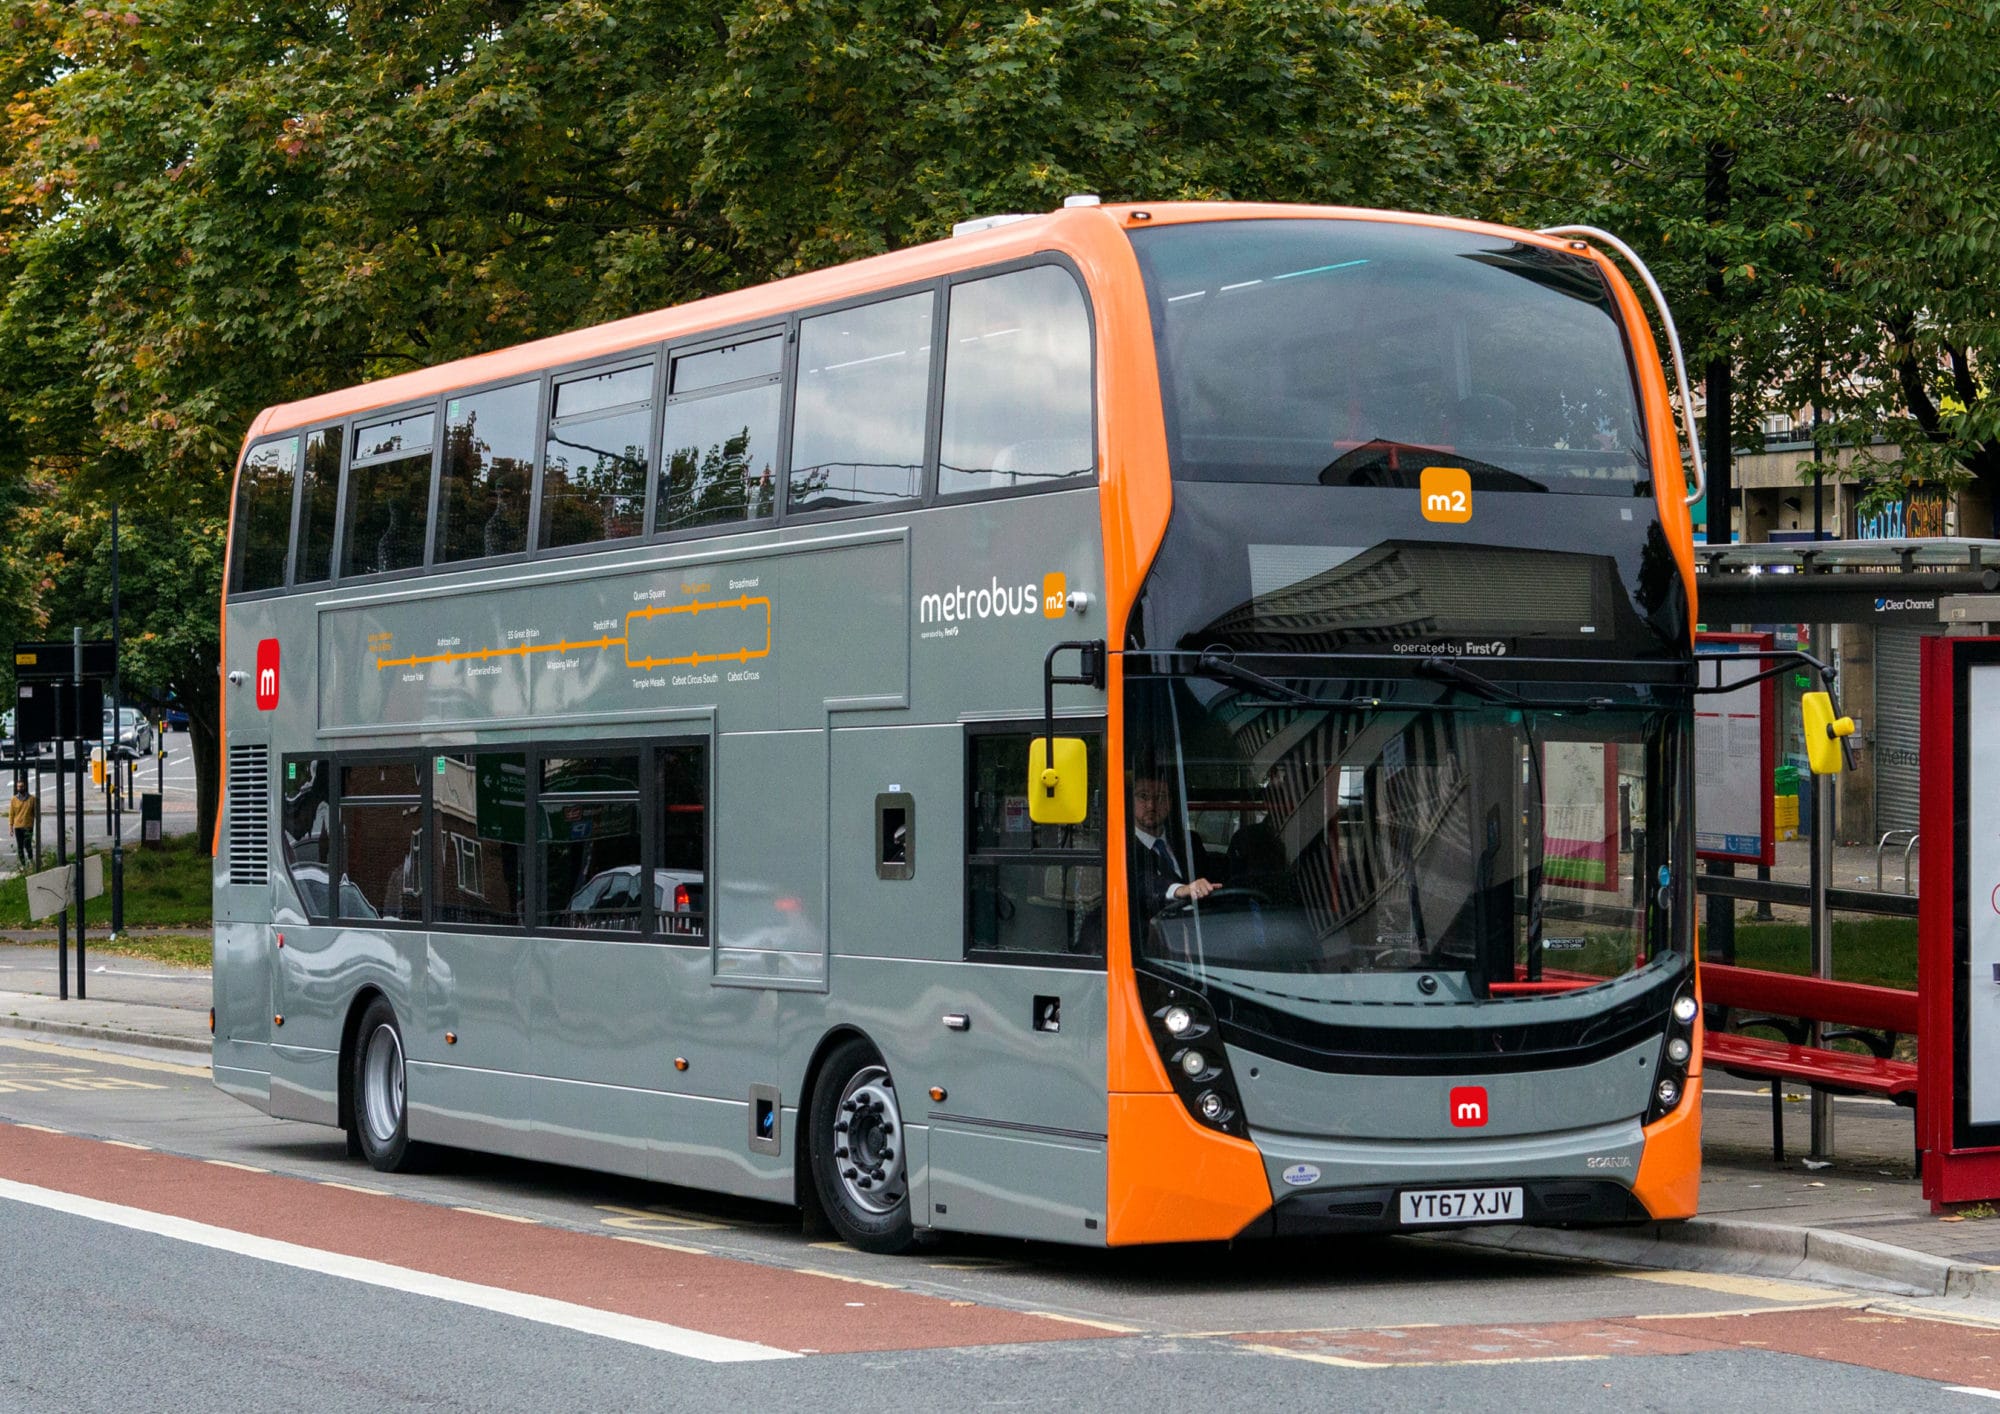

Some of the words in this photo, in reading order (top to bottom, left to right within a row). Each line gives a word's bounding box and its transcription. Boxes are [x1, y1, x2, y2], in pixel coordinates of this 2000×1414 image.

[1427, 490, 1467, 512] m2
[729, 576, 760, 589] Broadmead
[920, 575, 1038, 623] metrobus
[1045, 591, 1064, 610] m2
[1885, 599, 1904, 610] Clear
[1905, 598, 1935, 609] Channel
[1393, 642, 1445, 654] operated
[1447, 643, 1462, 656] by
[1466, 642, 1491, 654] First
[261, 668, 275, 696] m
[672, 676, 686, 686] Cabot
[687, 675, 702, 686] Circus
[702, 674, 719, 684] South
[727, 672, 743, 682] Cabot
[743, 671, 760, 681] Circus
[1457, 1102, 1481, 1120] m
[1587, 1156, 1632, 1169] SCANIA
[1410, 1193, 1466, 1218] YT67
[1473, 1191, 1512, 1215] XJV
